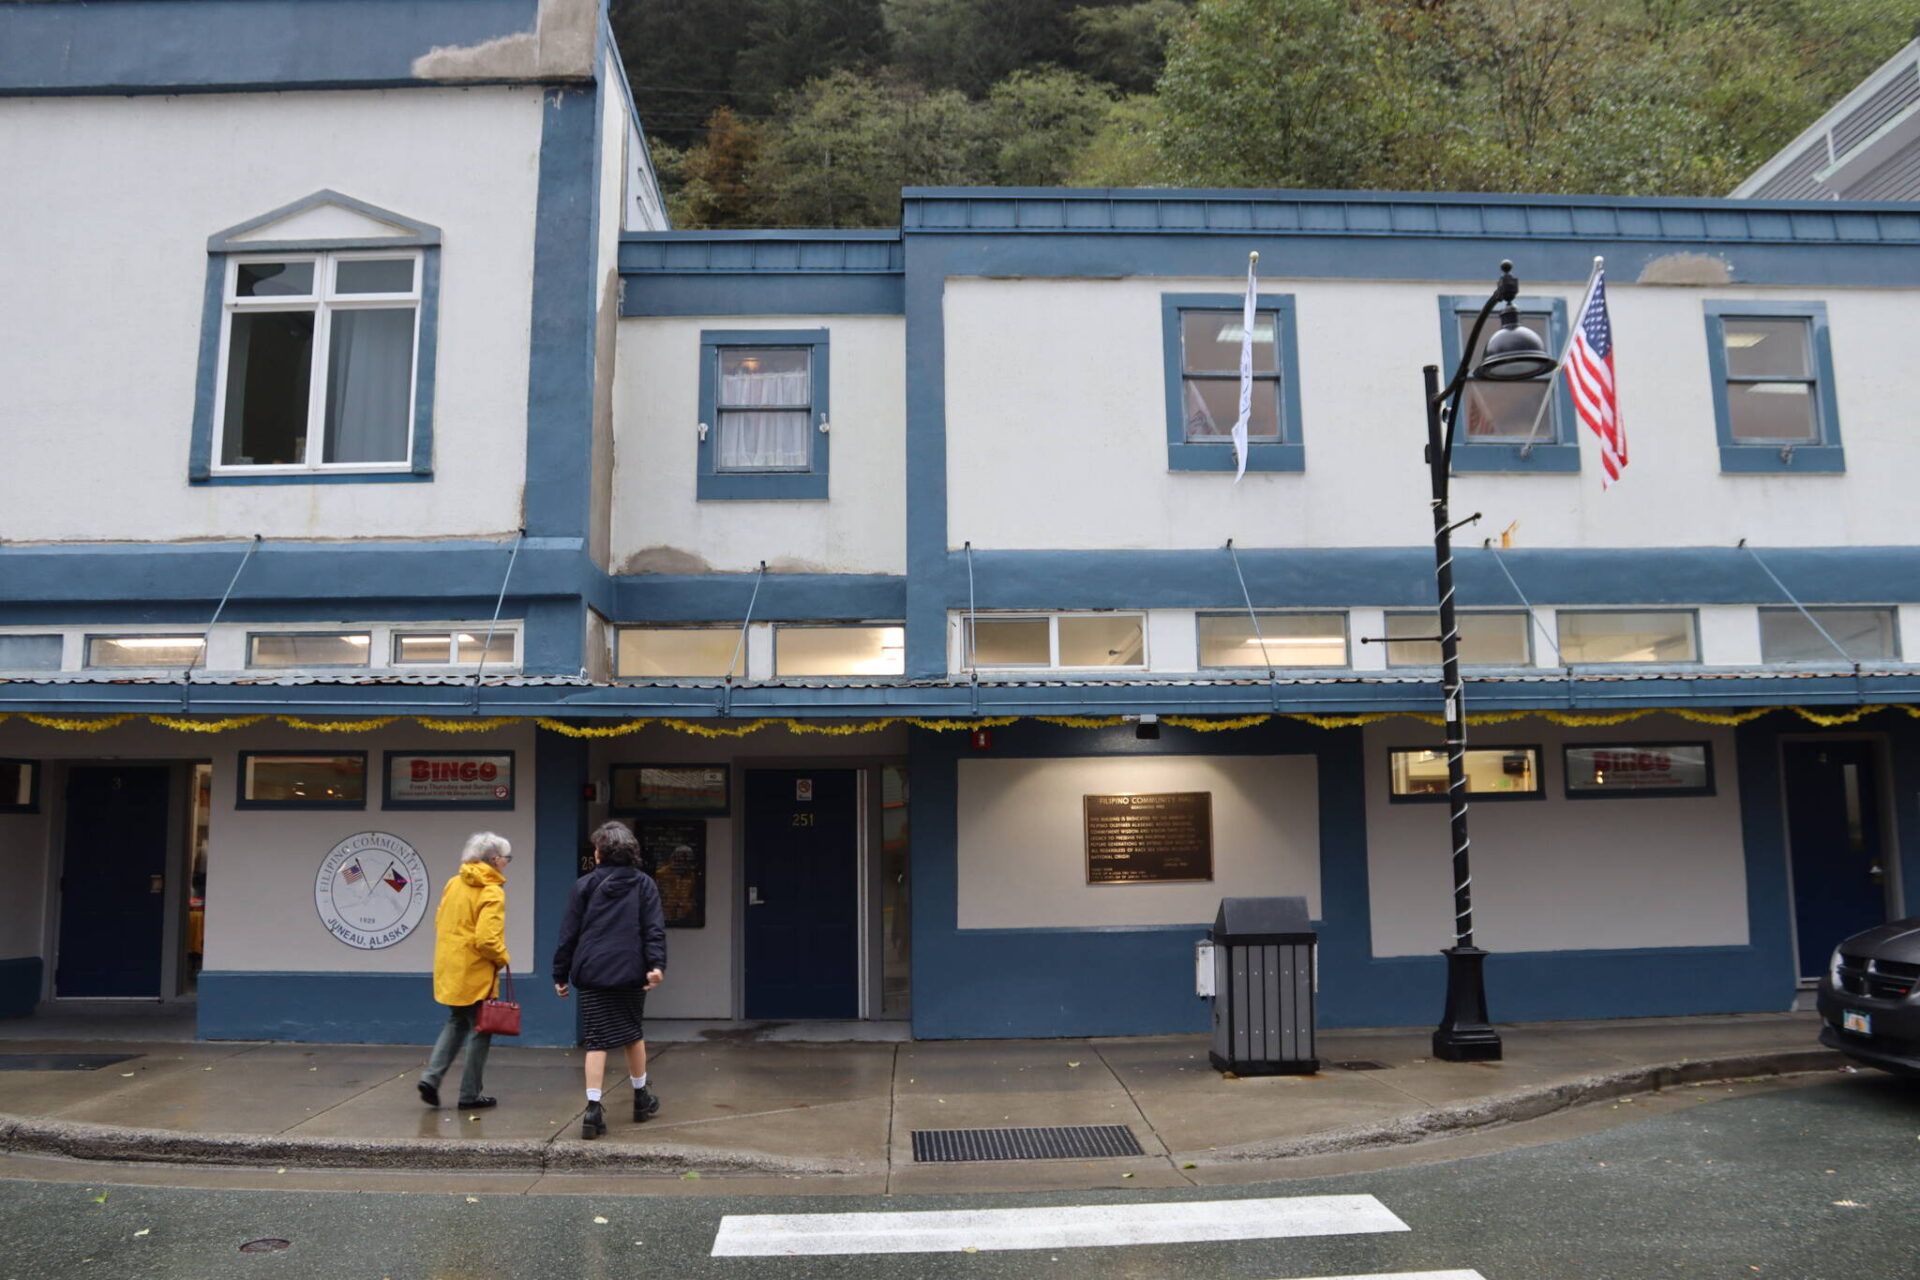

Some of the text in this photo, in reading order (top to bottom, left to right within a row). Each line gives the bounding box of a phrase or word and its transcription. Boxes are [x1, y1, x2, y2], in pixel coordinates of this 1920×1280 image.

[410, 760, 497, 782] BINGO
[1099, 797, 1129, 805] FILIPINO
[792, 813, 814, 827] 251
[319, 844, 351, 893] FILIPINO
[581, 856, 595, 870] 25
[369, 923, 409, 946] ALASKA
